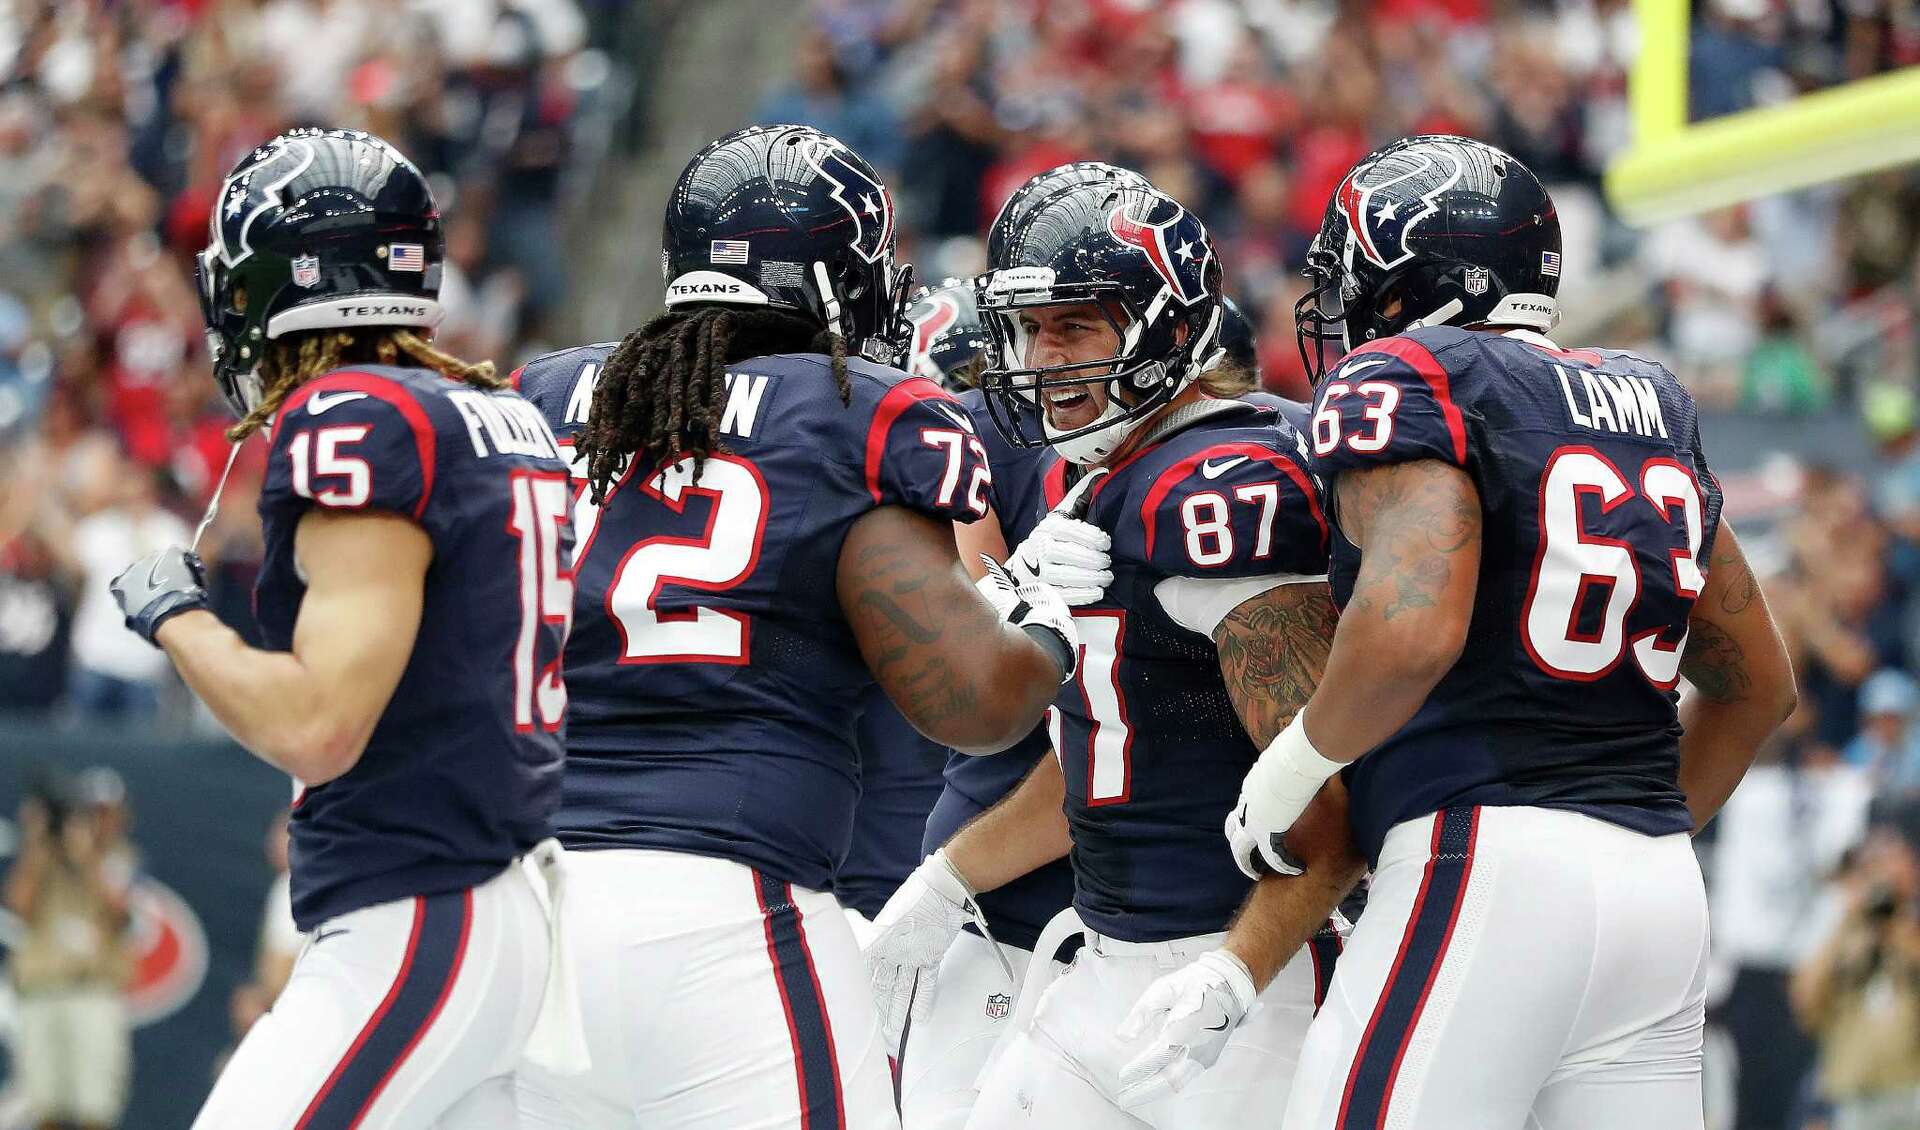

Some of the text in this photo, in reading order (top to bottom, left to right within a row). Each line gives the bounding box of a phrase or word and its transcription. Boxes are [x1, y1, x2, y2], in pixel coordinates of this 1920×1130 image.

[338, 306, 426, 317] TEXANS
[671, 283, 741, 296] TEXANS
[1468, 279, 1486, 291] NFL
[1511, 303, 1552, 315] TEXANS
[1310, 381, 1402, 458] 63
[1553, 364, 1669, 439] LAMM
[285, 424, 374, 510] 15
[919, 427, 992, 519] 72
[1179, 480, 1280, 568] 87
[505, 467, 577, 734] 15
[1520, 445, 1707, 690] 63
[1043, 609, 1135, 807] 7
[989, 1003, 1009, 1016] NFL
